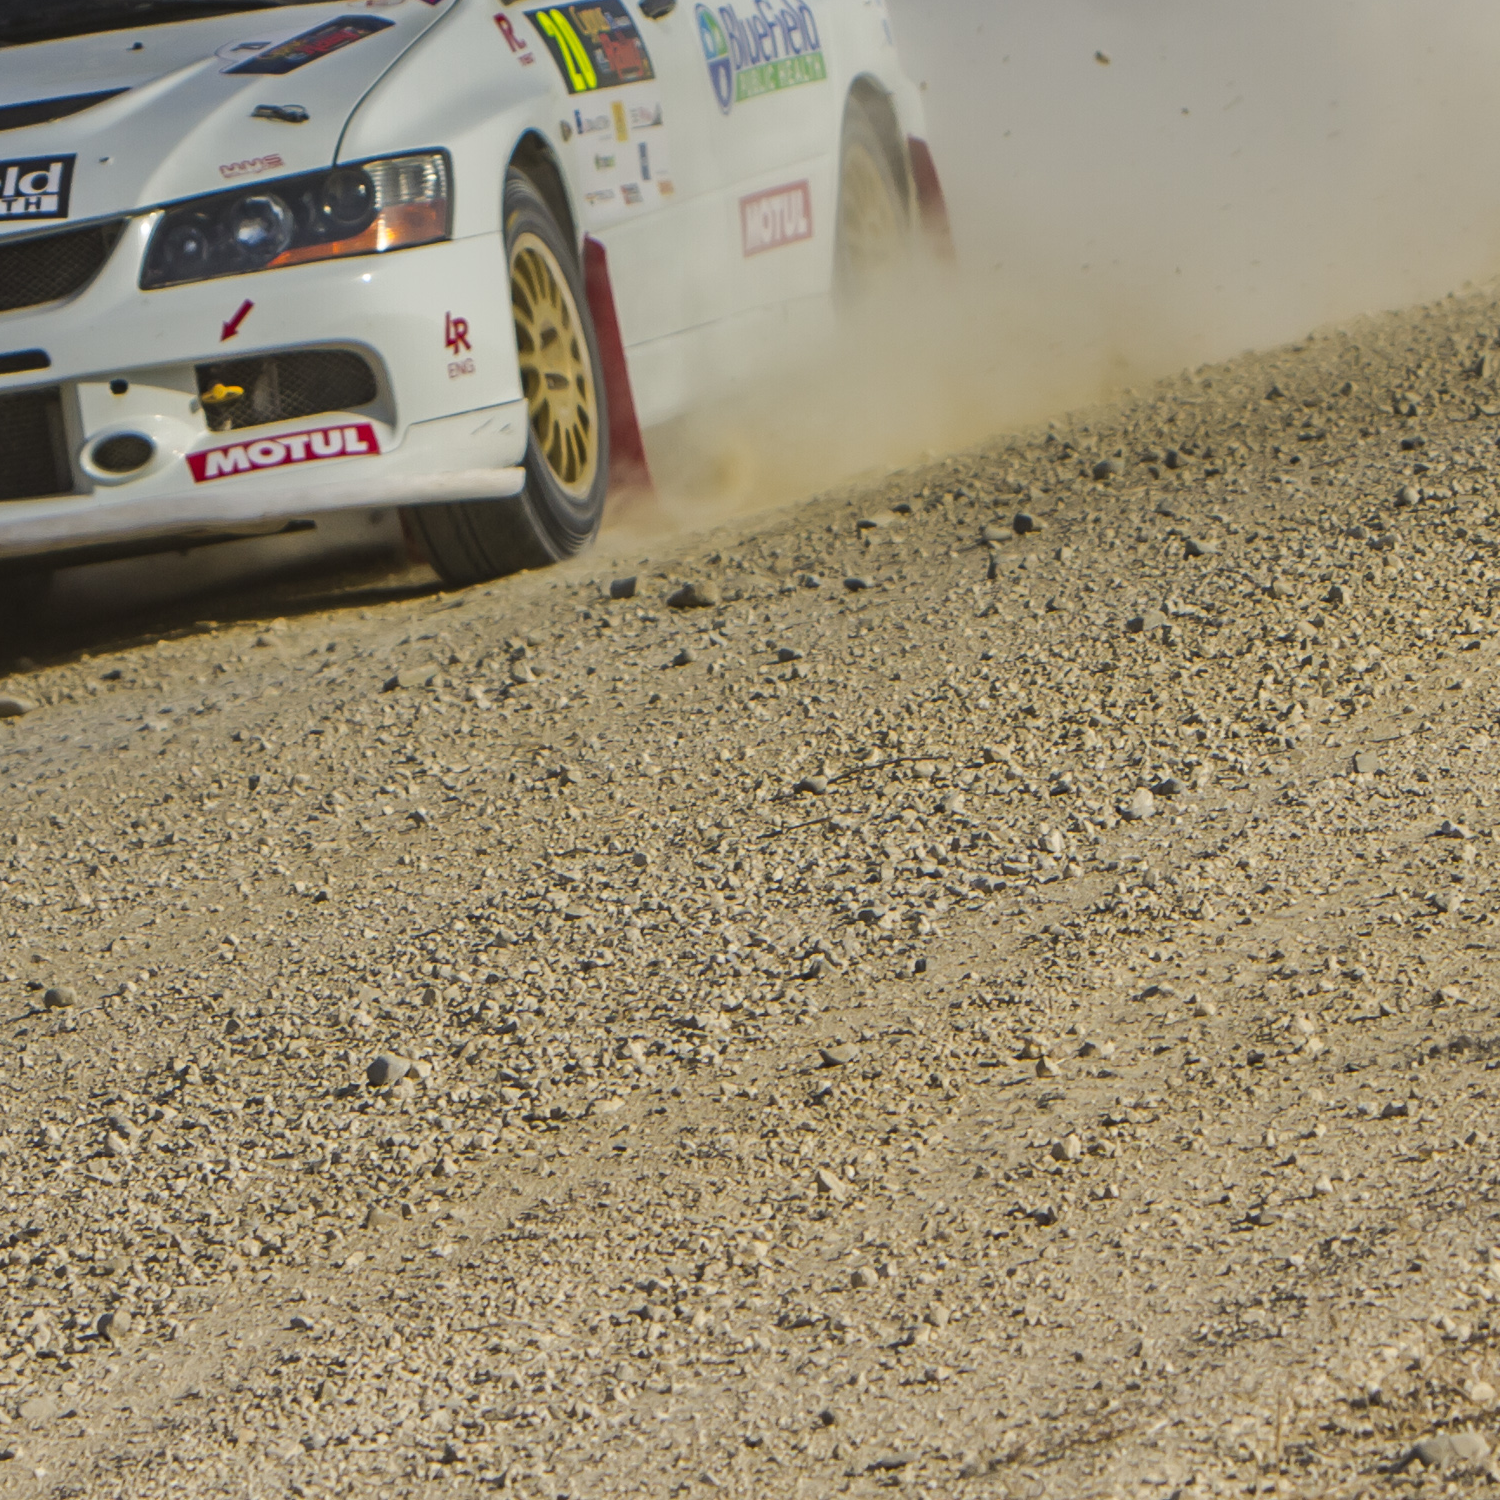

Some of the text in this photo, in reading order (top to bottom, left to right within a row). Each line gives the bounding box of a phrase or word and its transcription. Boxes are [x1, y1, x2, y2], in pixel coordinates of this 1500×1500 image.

[535, 8, 598, 92] 20
[746, 190, 808, 249] MOTUL
[447, 358, 476, 379] ENG
[203, 426, 369, 479] MOTUL
